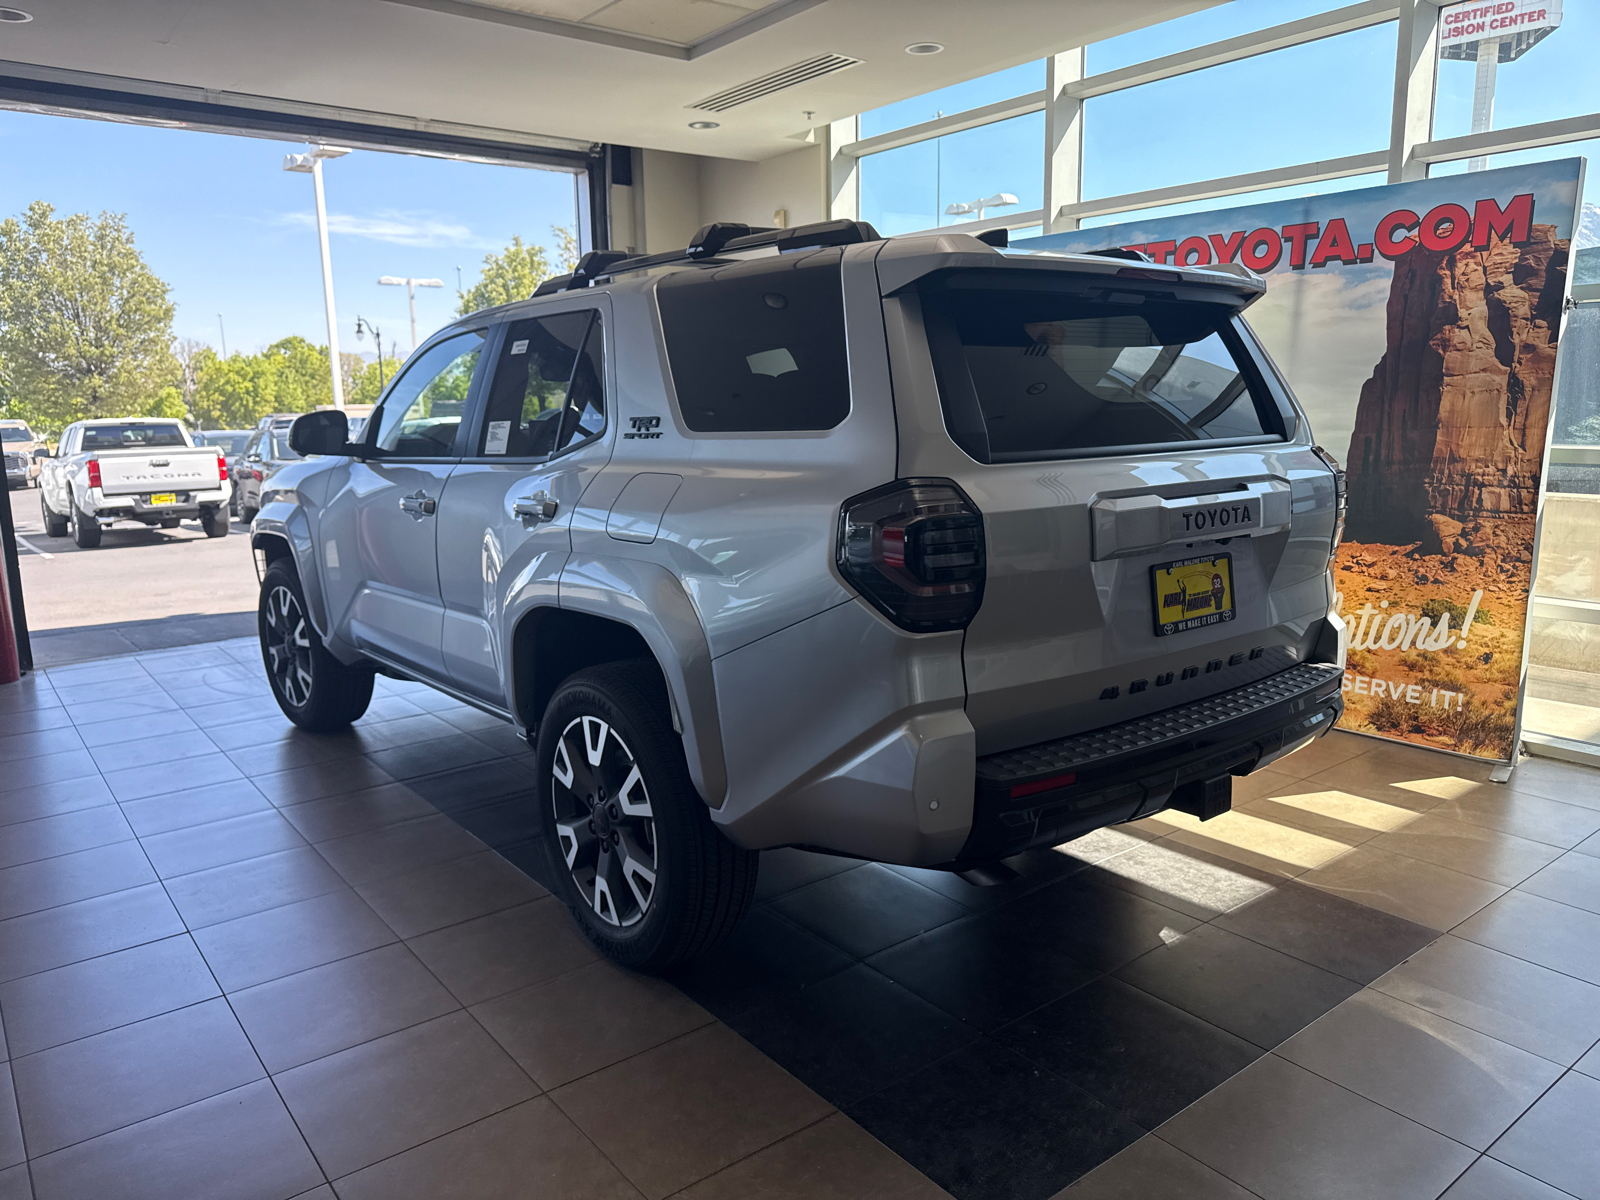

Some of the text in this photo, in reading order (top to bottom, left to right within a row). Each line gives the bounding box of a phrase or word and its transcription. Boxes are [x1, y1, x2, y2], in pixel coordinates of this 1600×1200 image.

[1444, 1, 1516, 25] CERTIFIED
[1489, 9, 1547, 30] CENTER
[629, 416, 661, 432] TRD
[623, 432, 664, 440] SPORT
[121, 472, 202, 480] TACOMA
[1182, 504, 1252, 532] TOYOTA
[1184, 558, 1200, 566] MALONE
[1213, 578, 1221, 588] 32
[1162, 592, 1213, 612] KARL MALONE
[1178, 614, 1220, 631] WE MAKE IT EASY
[1430, 690, 1464, 712] IT!
